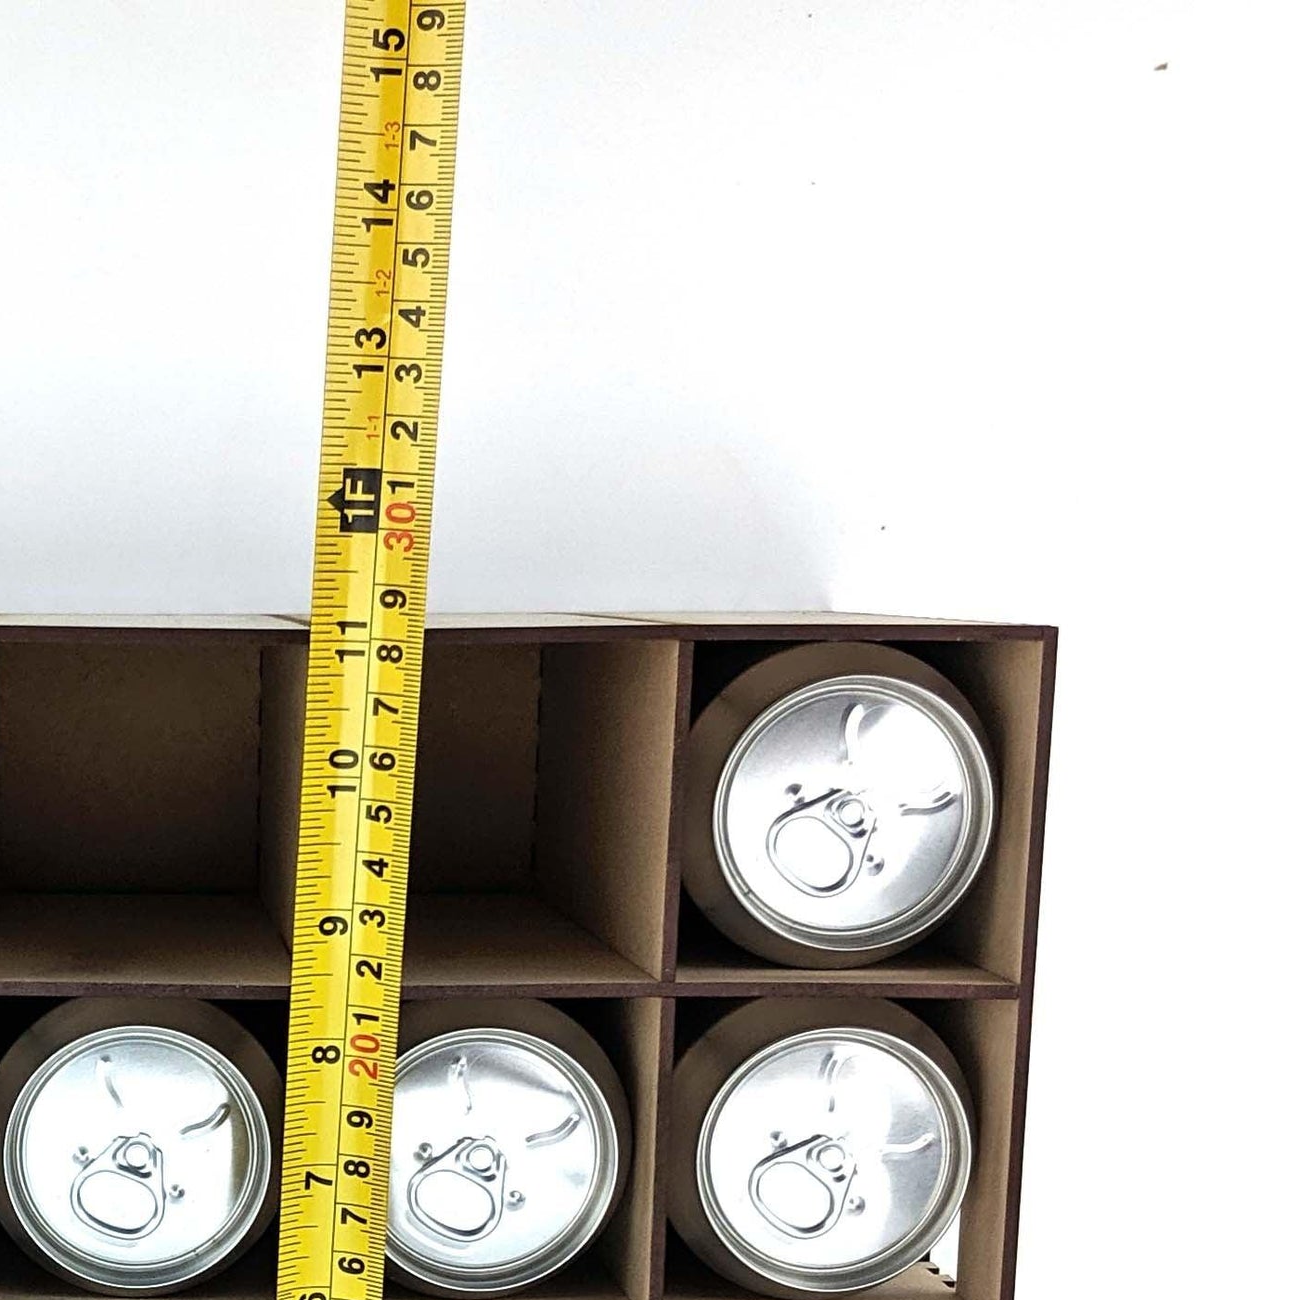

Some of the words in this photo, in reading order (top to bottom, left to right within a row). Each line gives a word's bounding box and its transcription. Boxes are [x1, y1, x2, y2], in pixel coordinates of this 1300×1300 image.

[416, 9, 445, 31] 9
[370, 28, 405, 82] 15
[413, 70, 441, 91] 8
[384, 121, 400, 150] 1-3
[409, 130, 437, 150] 7
[361, 179, 395, 232] 14
[406, 190, 434, 210] 6
[402, 248, 430, 268] 5
[375, 269, 391, 297] 1-2
[398, 305, 426, 328] 4
[353, 327, 386, 379] 13
[394, 363, 422, 384] 3
[367, 415, 380, 440] 1-1
[390, 421, 418, 442] 2
[387, 480, 415, 494] 1
[342, 478, 375, 523] 1F
[383, 502, 416, 553] 30
[379, 589, 407, 609] 9
[335, 621, 367, 663] 11
[376, 644, 403, 664] 8
[372, 697, 399, 716] 7
[369, 751, 396, 771] 6
[327, 749, 359, 798] 10
[365, 805, 393, 824] 5
[362, 858, 389, 878] 4
[318, 915, 348, 935] 9
[359, 909, 386, 928] 3
[355, 960, 382, 980] 2
[352, 1012, 380, 1025] 1
[311, 1045, 340, 1064] 8
[348, 1034, 380, 1080] 20
[346, 1110, 373, 1129] 9
[343, 1160, 370, 1178] 8
[304, 1171, 333, 1190] 7
[341, 1207, 367, 1225] 7
[338, 1257, 365, 1275] 6
